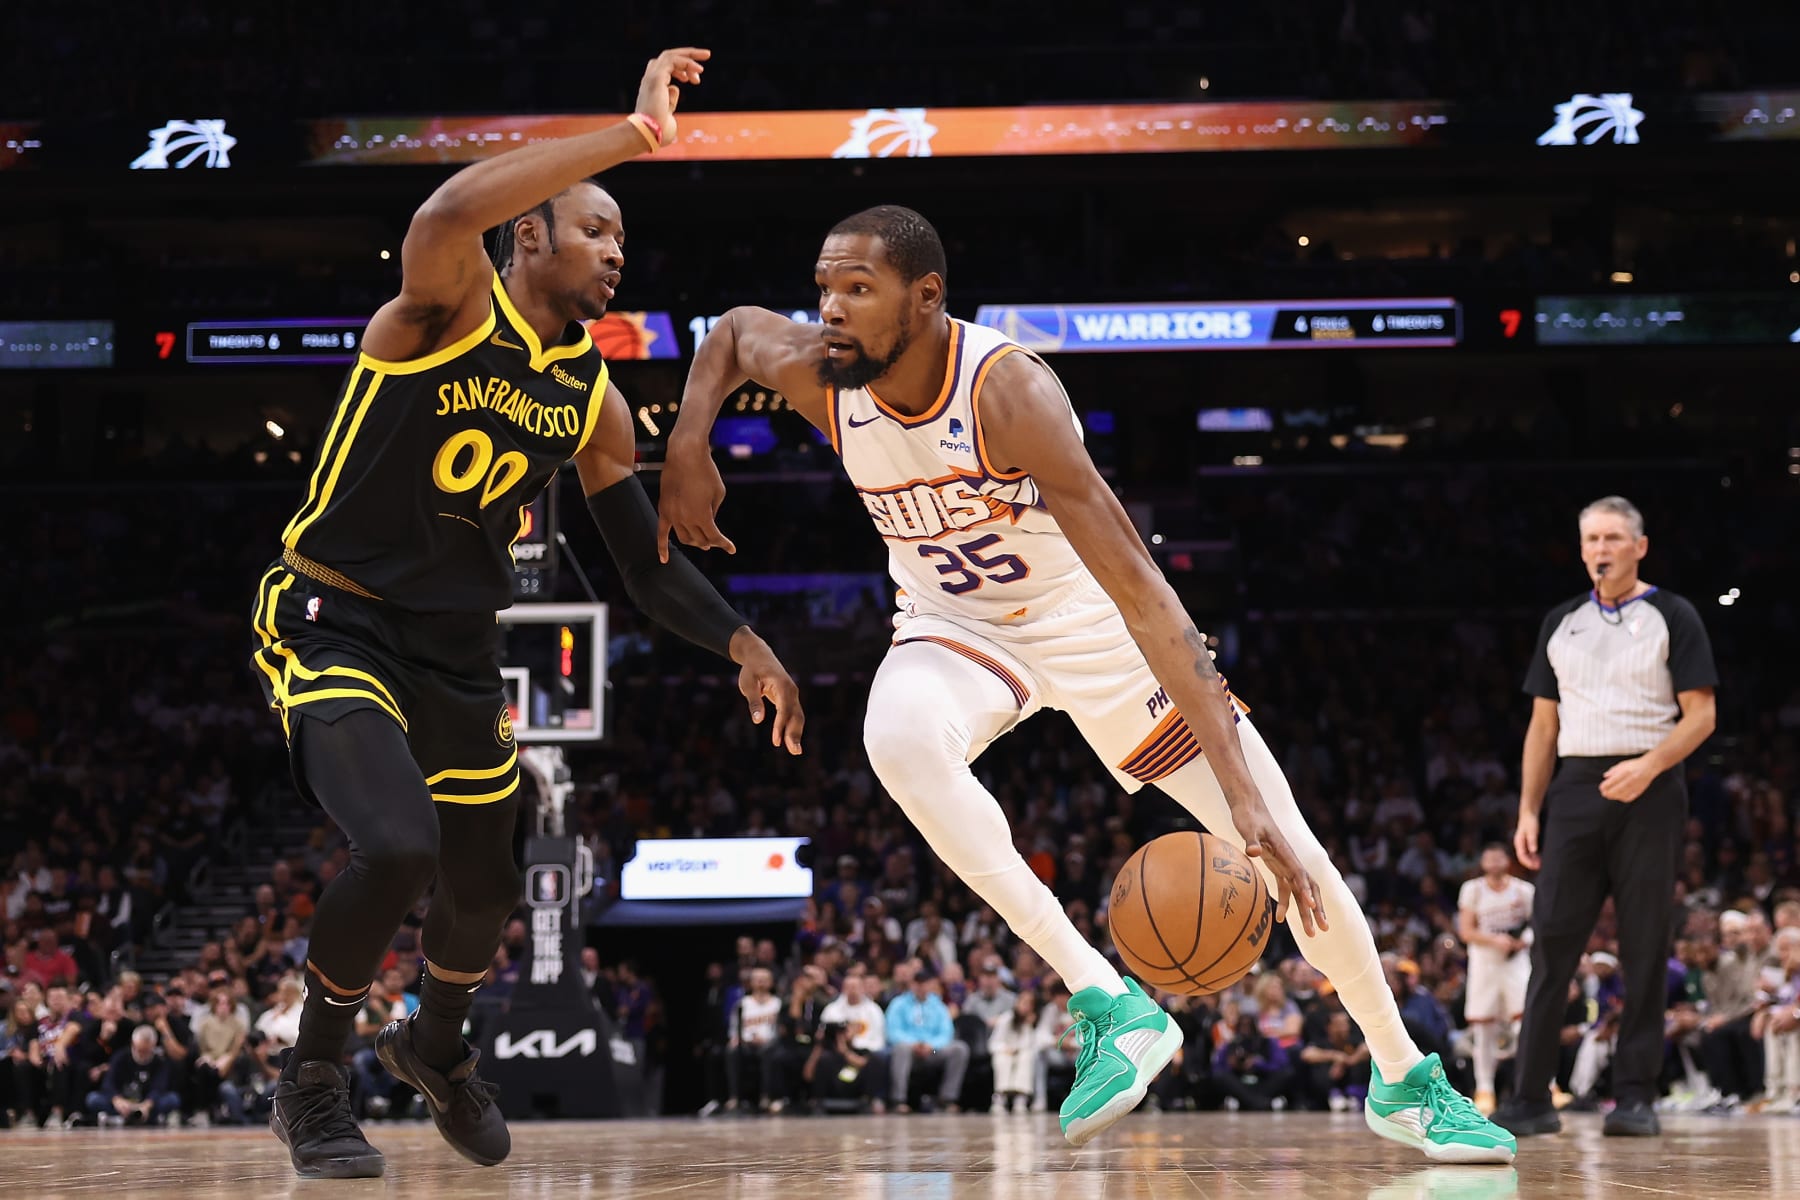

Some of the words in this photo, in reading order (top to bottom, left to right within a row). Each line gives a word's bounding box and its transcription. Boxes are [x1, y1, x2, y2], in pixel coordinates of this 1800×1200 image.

[1073, 311, 1252, 341] WARRIORS
[1500, 309, 1521, 338] 7
[155, 332, 176, 359] 7
[268, 333, 280, 350] 6
[551, 365, 587, 392] Rakuten
[940, 439, 971, 454] PayPa
[432, 429, 529, 510] 00
[863, 480, 992, 539] SUNS
[918, 533, 1031, 595] 35
[1146, 686, 1170, 719] PH
[495, 1028, 597, 1060] KIA
